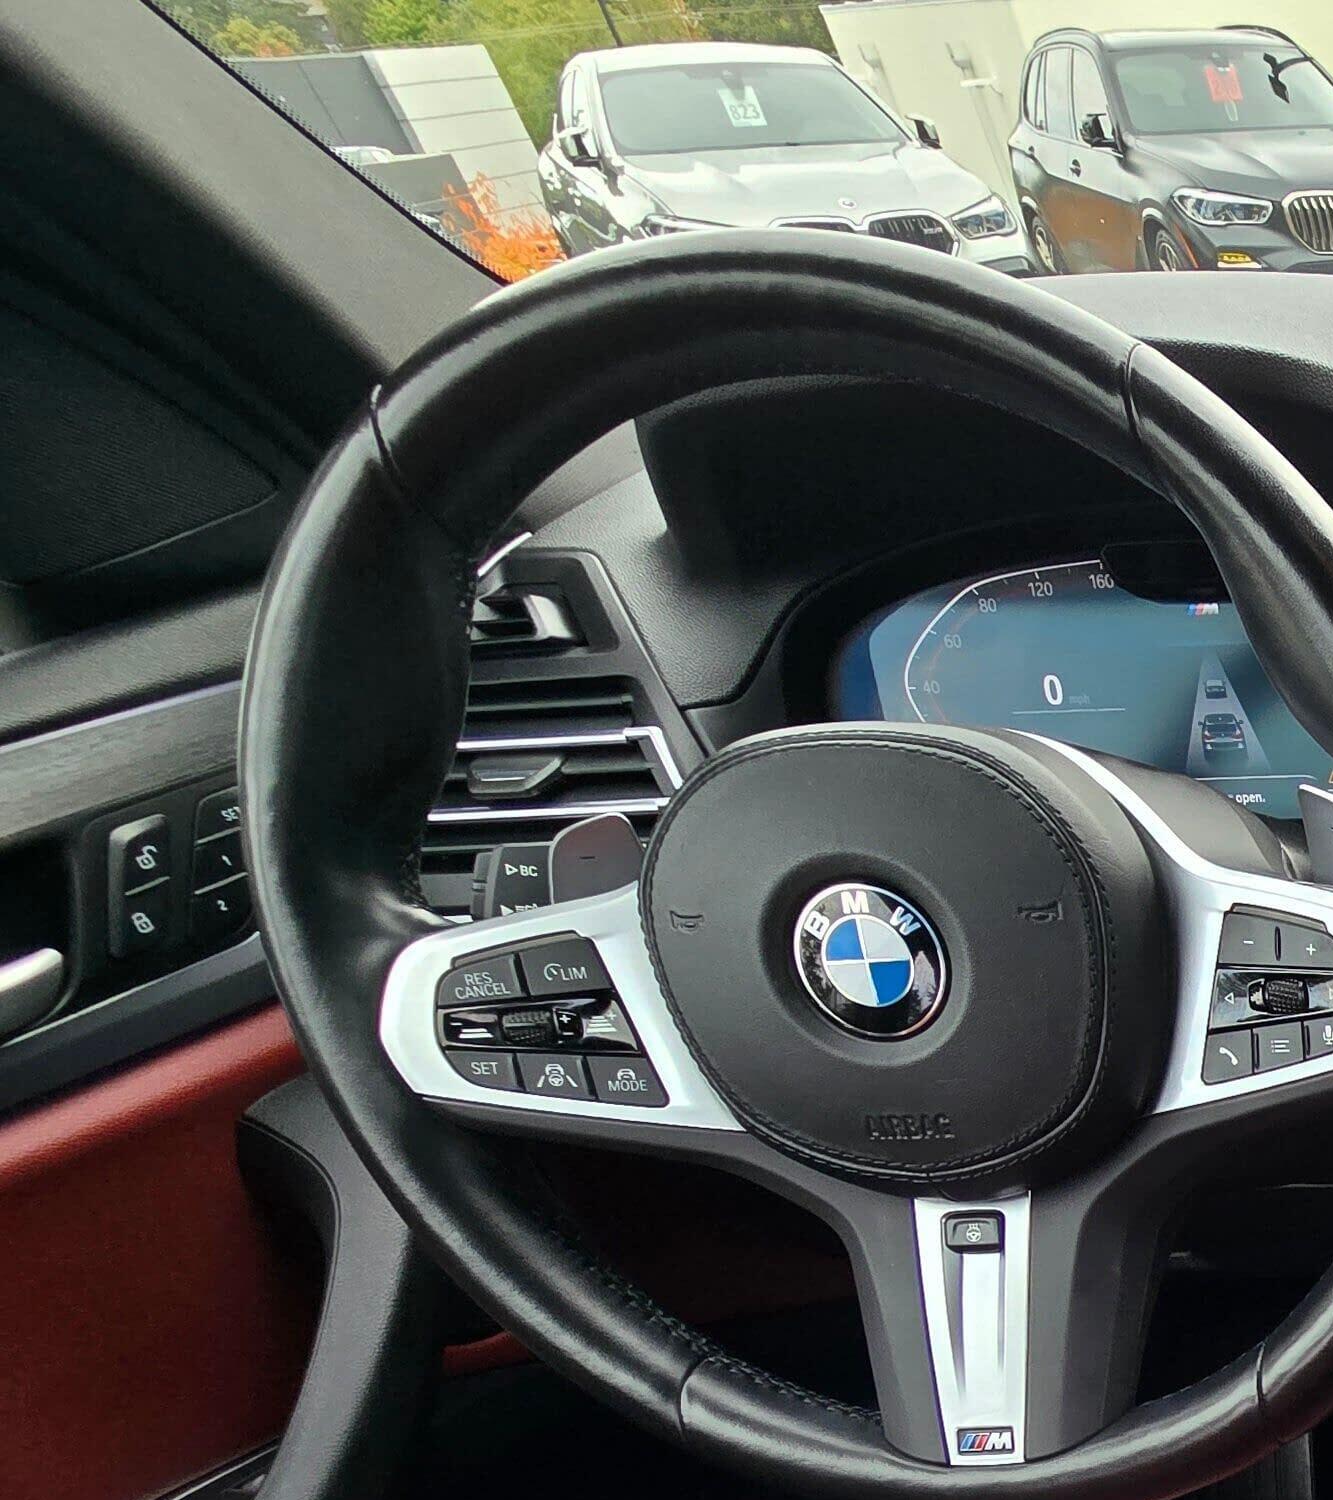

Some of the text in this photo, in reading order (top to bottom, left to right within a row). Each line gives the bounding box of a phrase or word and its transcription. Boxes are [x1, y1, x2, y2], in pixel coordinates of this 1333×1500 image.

[729, 104, 760, 120] 823
[1088, 573, 1114, 589] 160
[1028, 581, 1053, 597] 120
[978, 598, 997, 613] 80
[944, 634, 962, 649] 60
[923, 681, 940, 694] 40
[1043, 674, 1063, 706] 0
[1235, 793, 1266, 806] open.
[519, 865, 538, 877] BC
[217, 900, 228, 911] 2
[803, 890, 921, 940] BMW
[464, 971, 493, 985] RES
[561, 967, 588, 981] LIM
[454, 982, 510, 1000] CANCEL
[470, 1061, 498, 1075] SET
[608, 1080, 648, 1093] MODE
